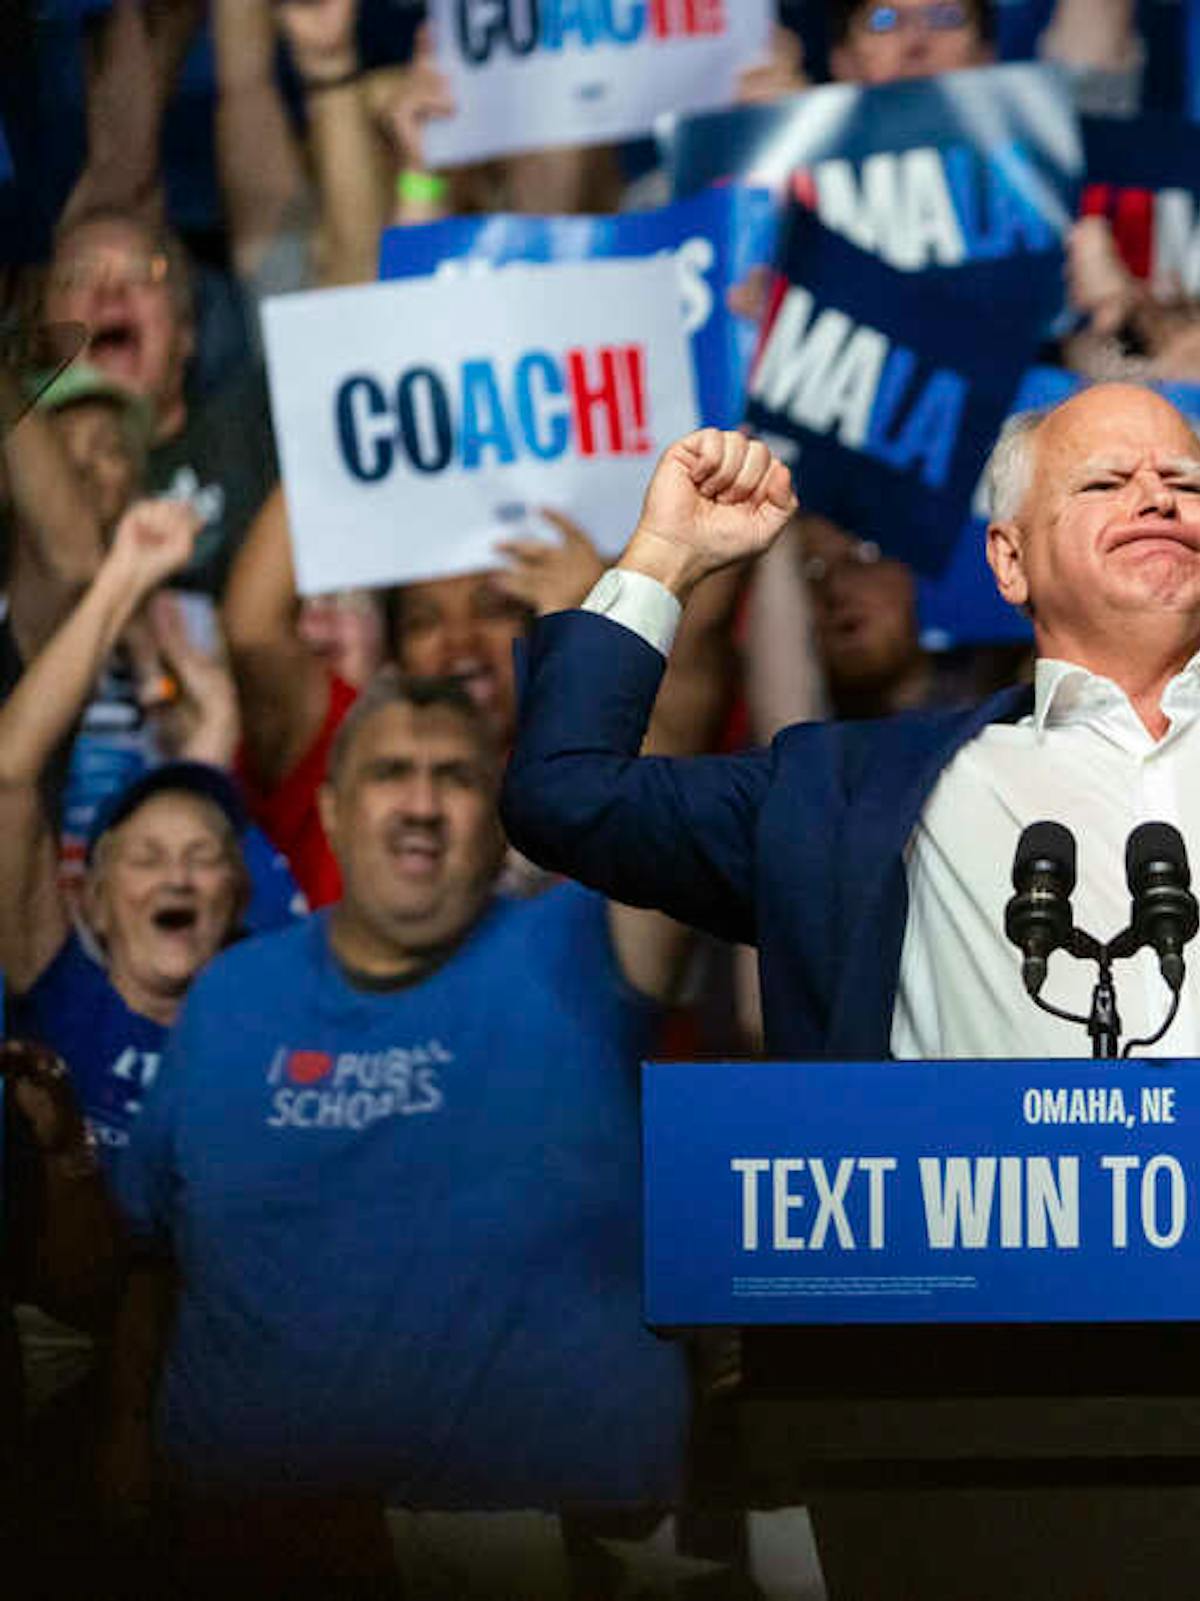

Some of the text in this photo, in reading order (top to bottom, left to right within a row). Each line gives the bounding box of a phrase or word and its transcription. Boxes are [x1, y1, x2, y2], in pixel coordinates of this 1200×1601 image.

[336, 343, 653, 485] COACH!
[1023, 1087, 1176, 1130] OMAHA, NE
[730, 1157, 899, 1251] TEXT
[918, 1156, 1080, 1250] WIN
[1101, 1153, 1187, 1249] TO
